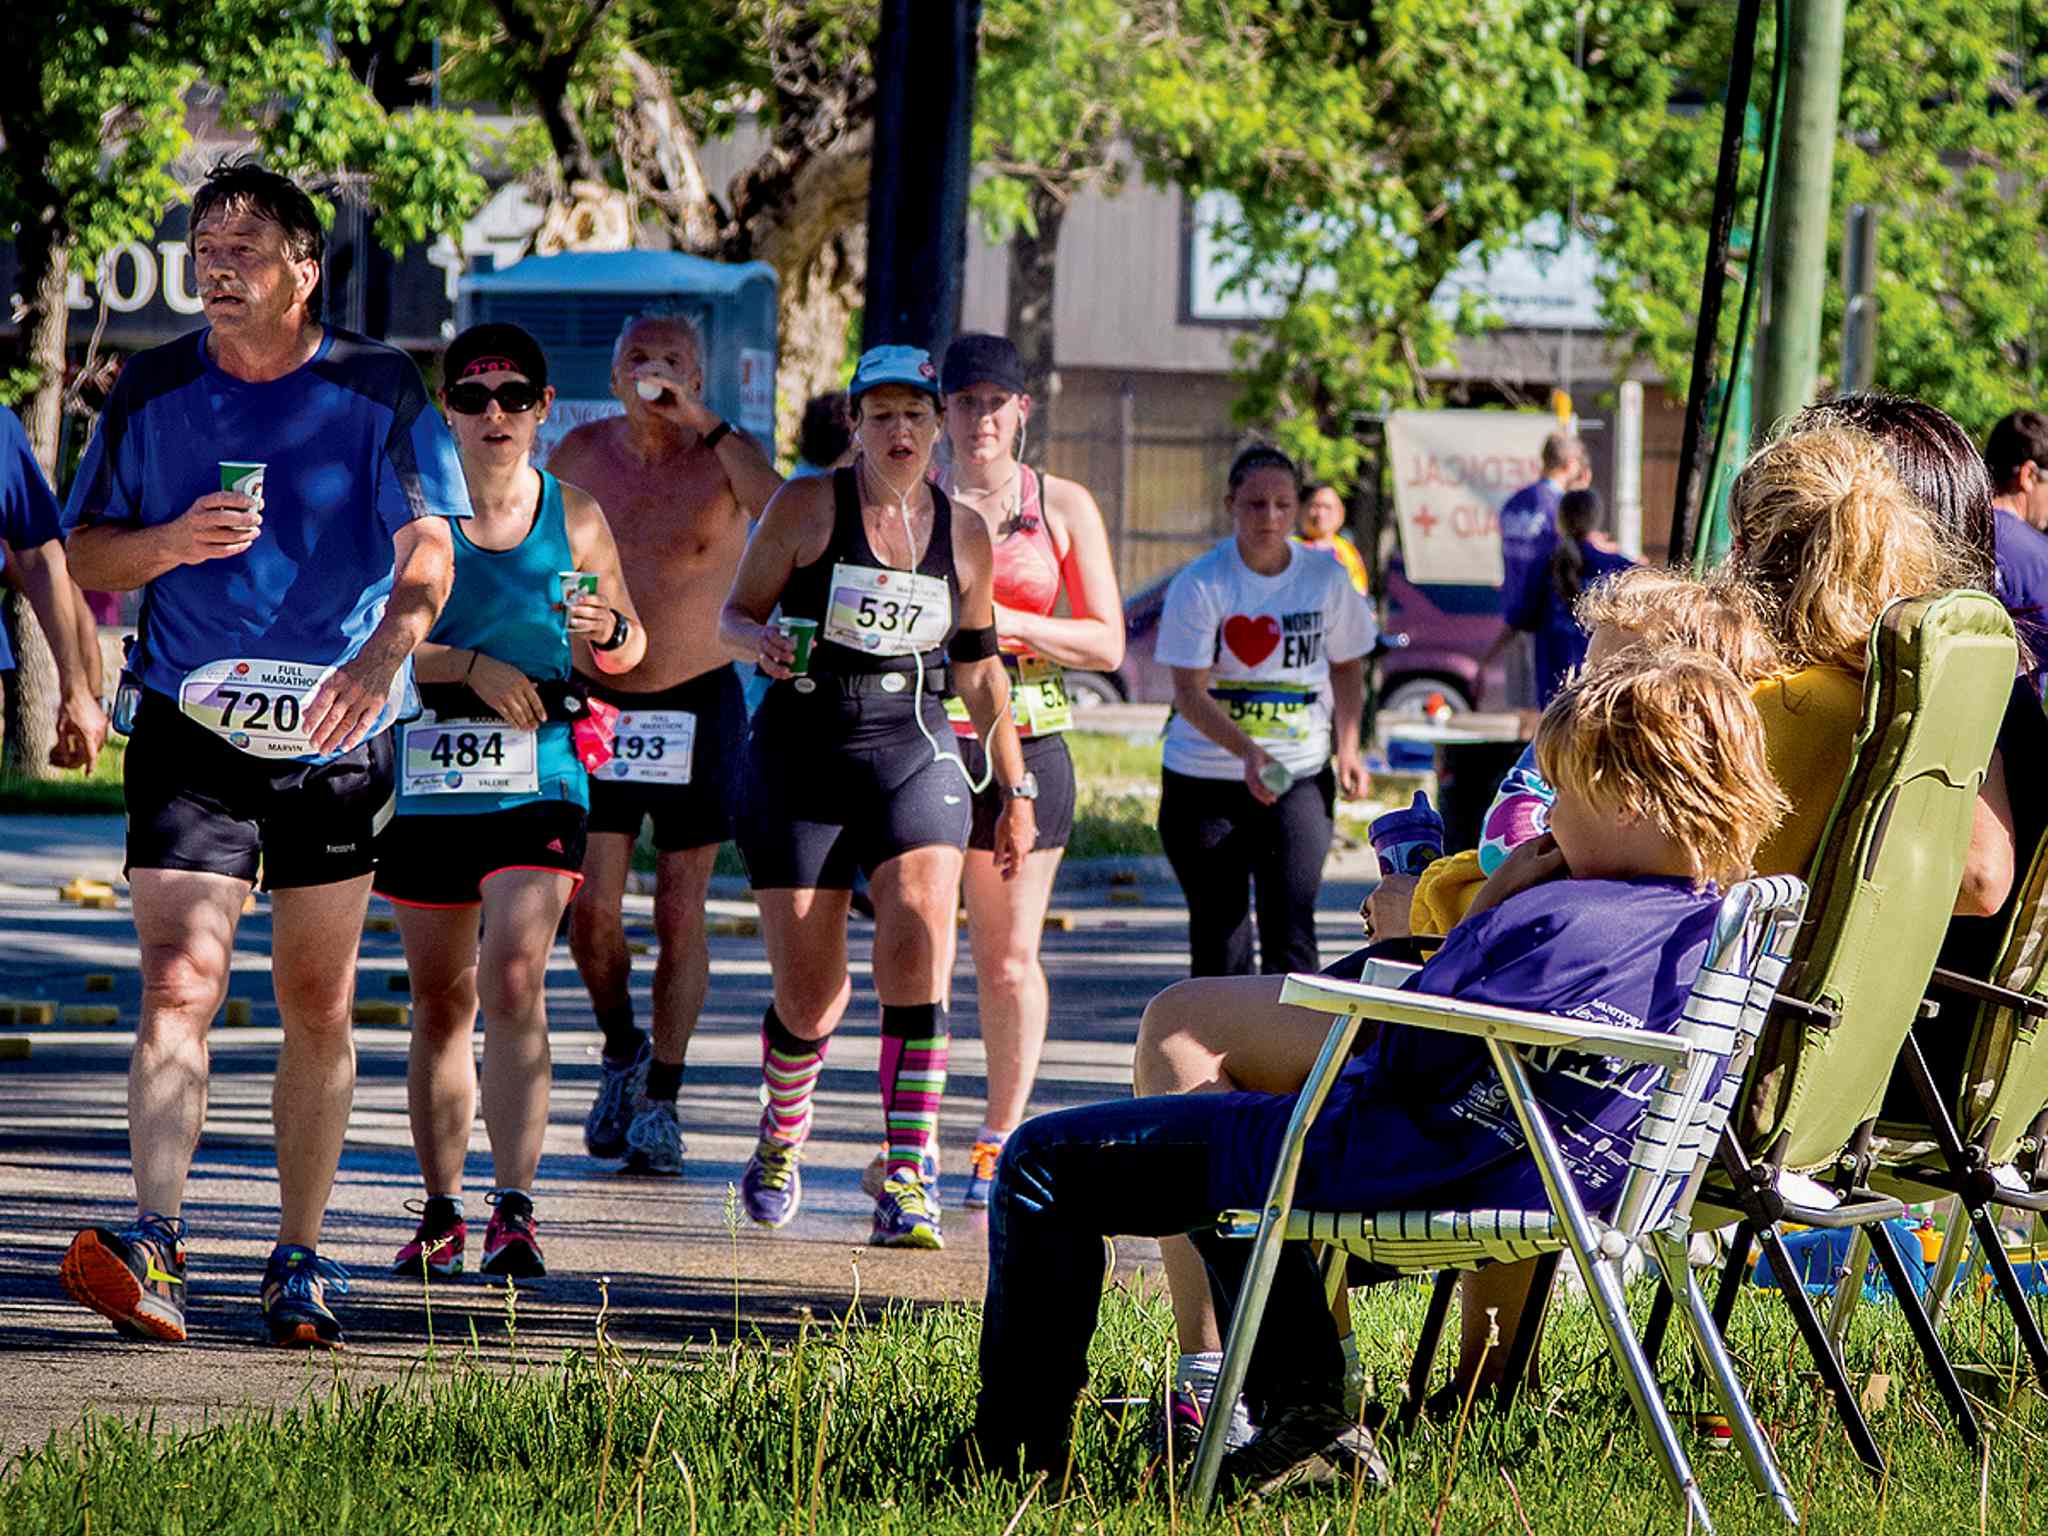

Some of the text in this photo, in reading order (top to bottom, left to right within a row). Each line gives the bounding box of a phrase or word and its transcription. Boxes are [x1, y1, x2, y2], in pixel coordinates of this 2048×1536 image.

[64, 239, 204, 315] OU
[856, 596, 924, 634] 537
[1281, 611, 1323, 632] NORT
[278, 665, 304, 677] FULL
[217, 690, 300, 732] 720
[268, 743, 304, 753] MARVIN
[431, 732, 505, 768] 484
